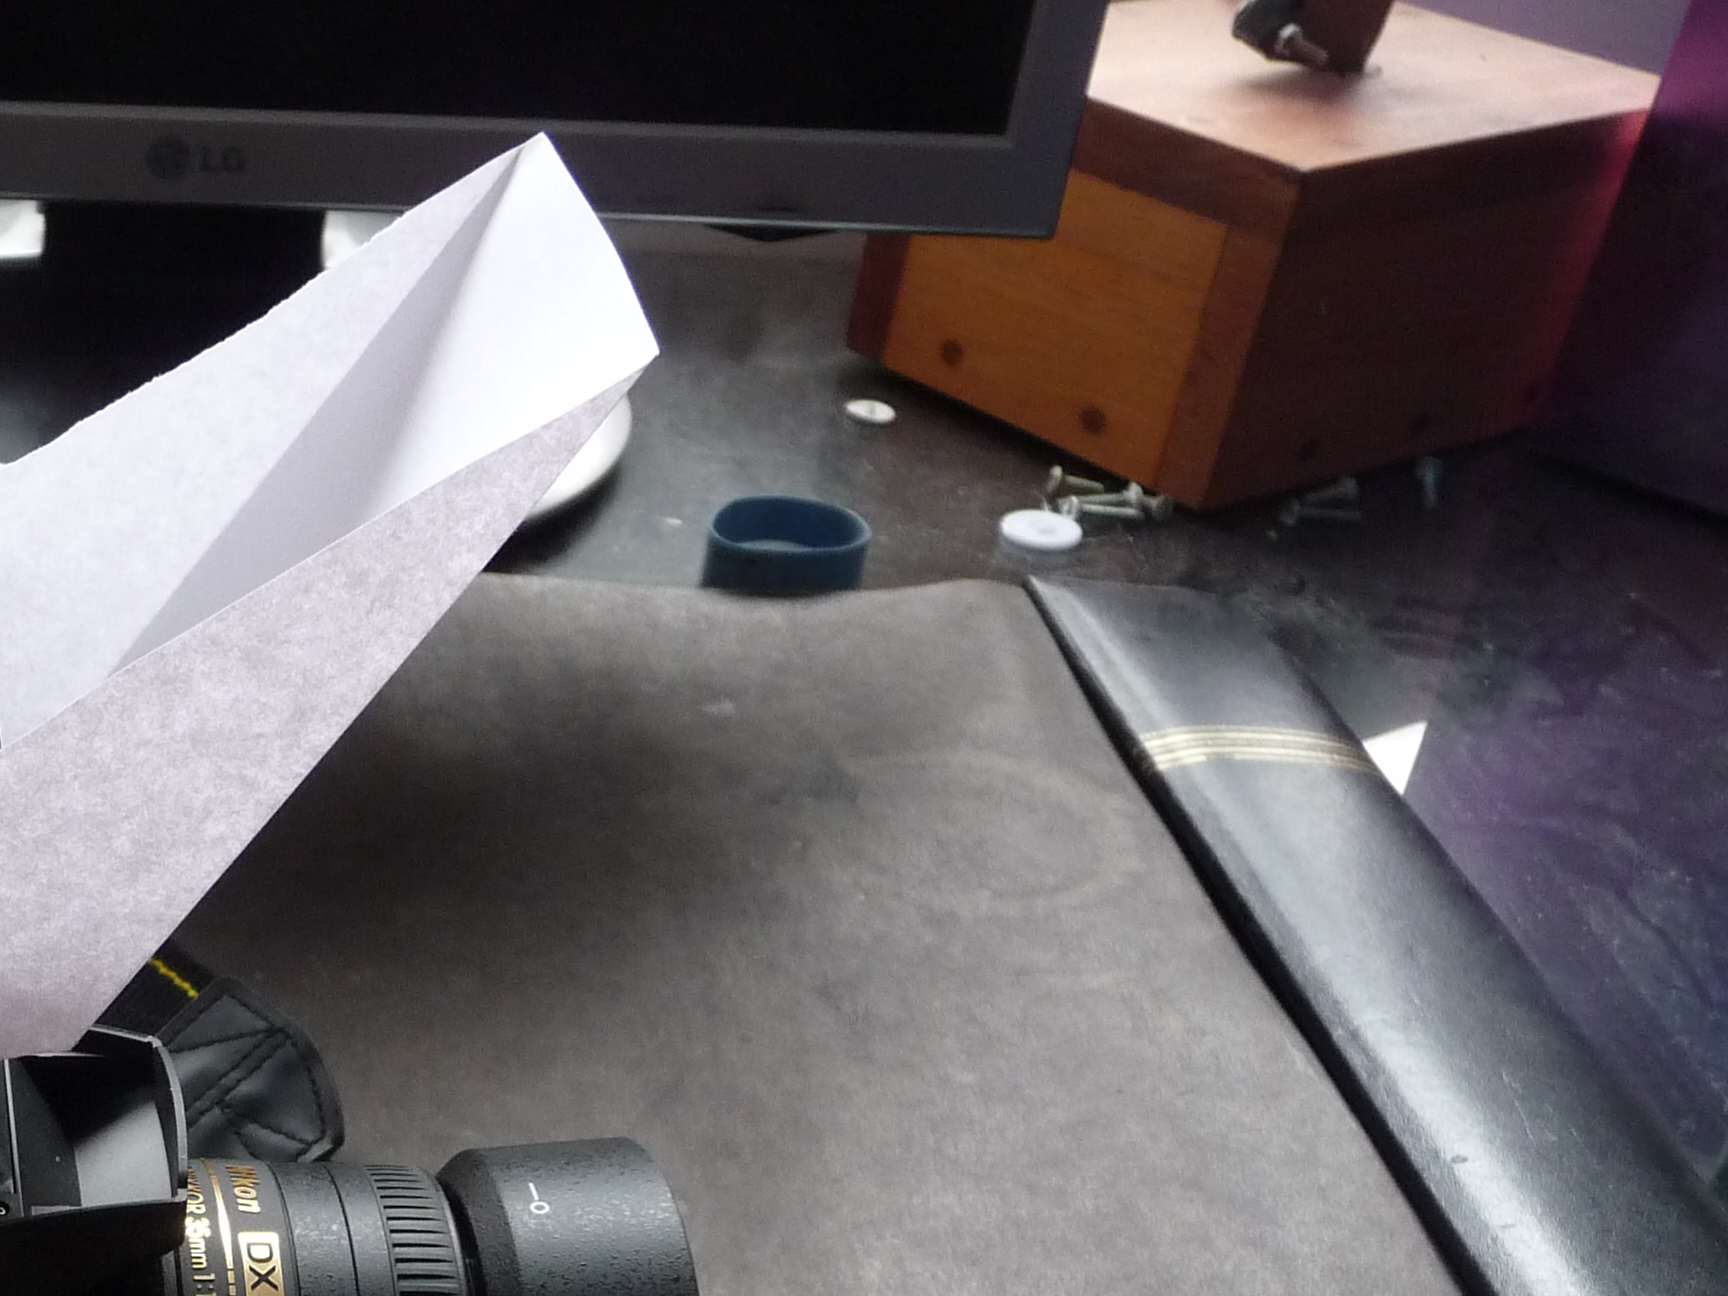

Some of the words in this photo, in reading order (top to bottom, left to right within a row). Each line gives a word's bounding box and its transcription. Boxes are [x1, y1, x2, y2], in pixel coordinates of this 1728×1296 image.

[199, 145, 246, 173] LG
[225, 1165, 261, 1214] Nikon
[247, 1242, 279, 1291] DX
